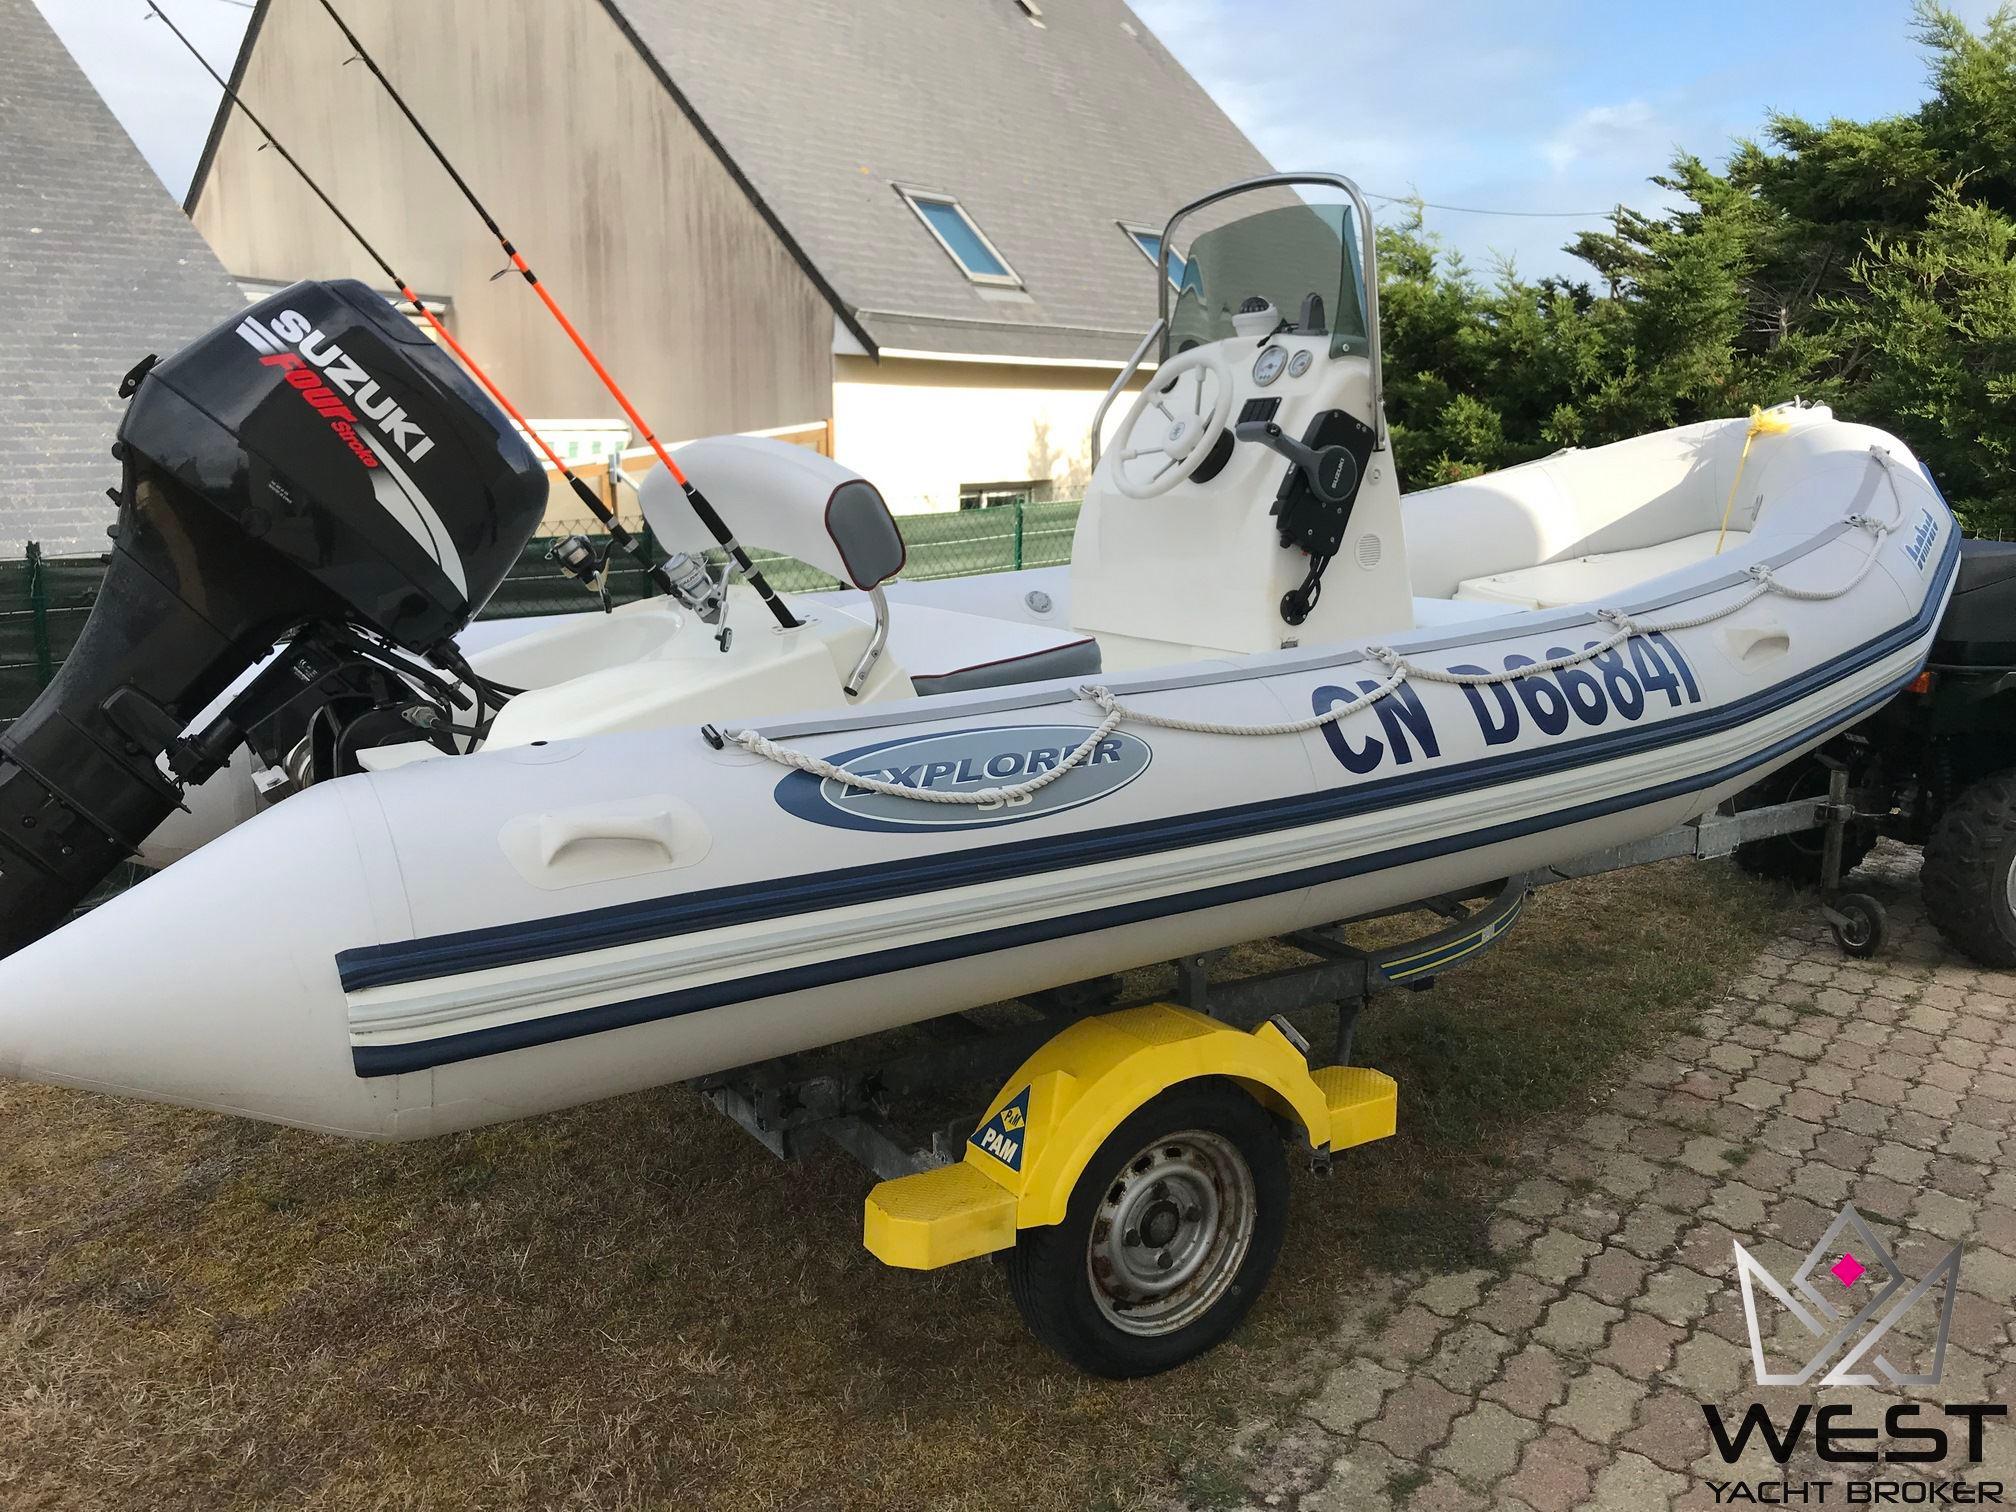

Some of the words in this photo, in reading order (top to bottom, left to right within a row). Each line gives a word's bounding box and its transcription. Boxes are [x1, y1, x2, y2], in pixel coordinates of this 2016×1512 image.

[269, 309, 436, 463] SUZUKI
[1331, 457, 1344, 489] SUZUKI
[1312, 678, 1440, 774] CN
[1447, 631, 1702, 747] D66841
[980, 1127, 1019, 1163] PAM
